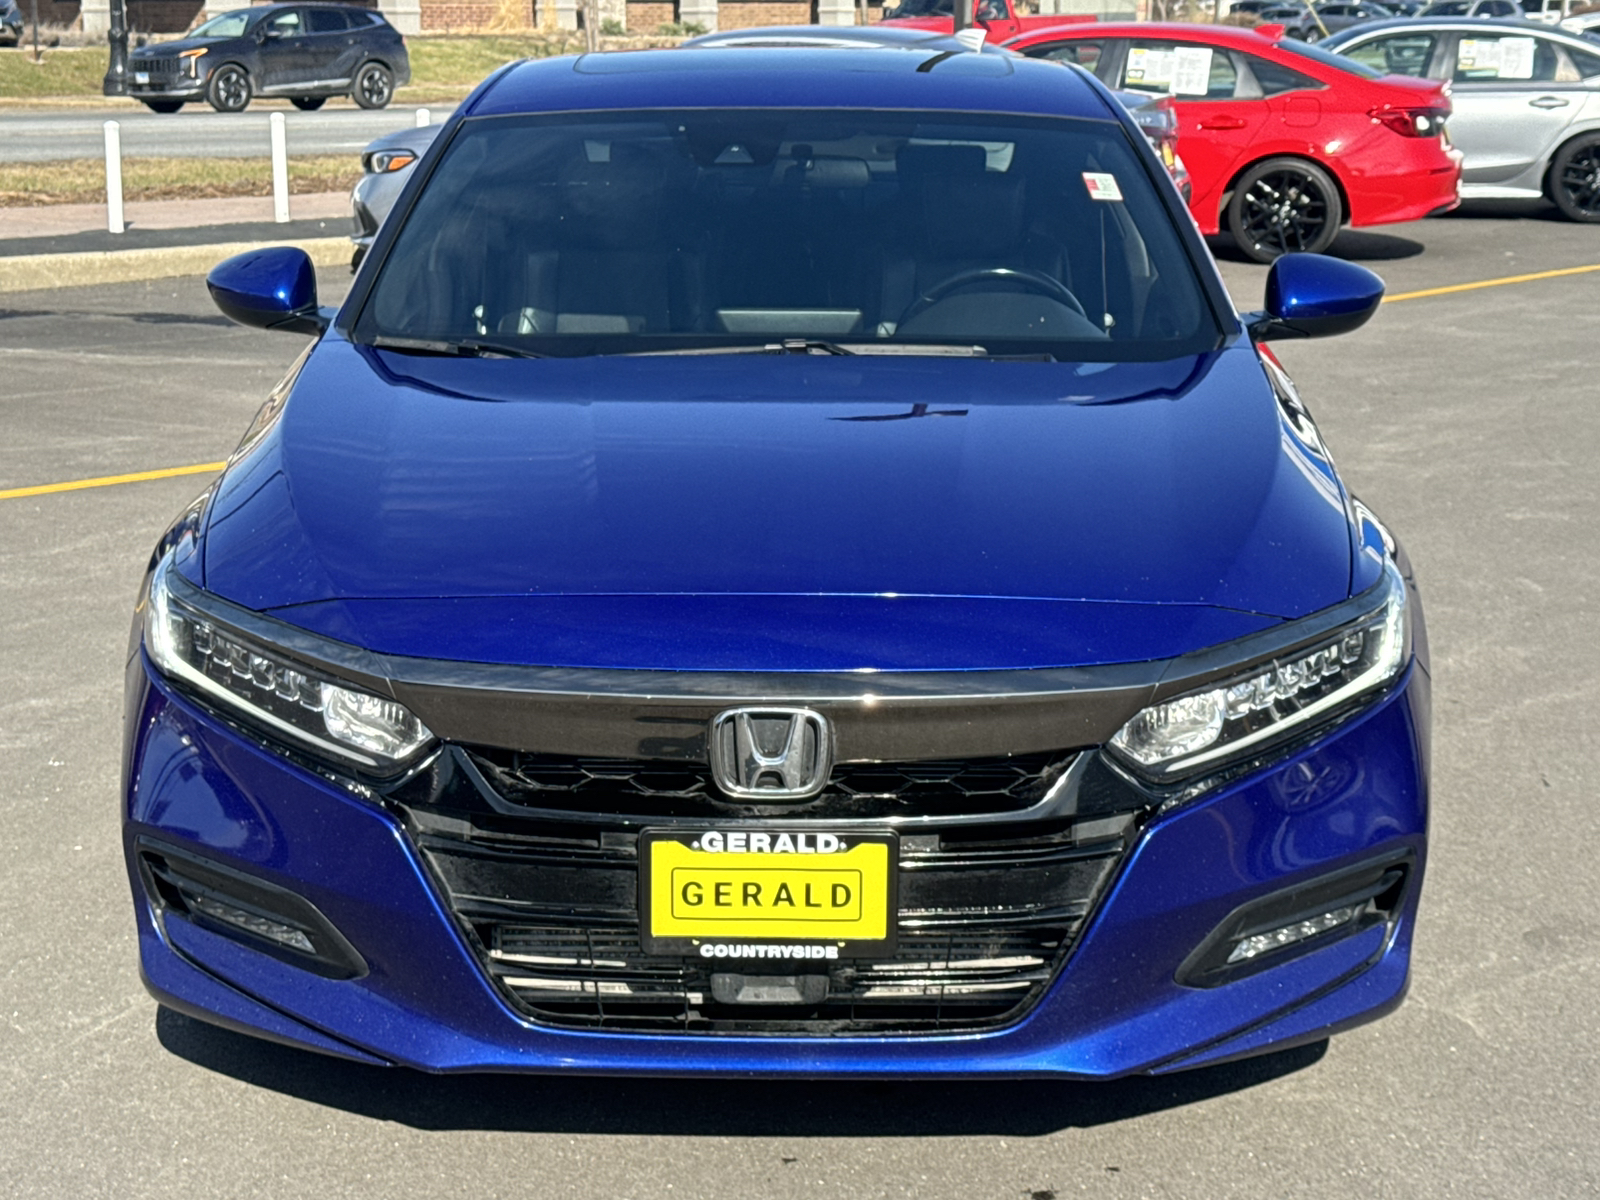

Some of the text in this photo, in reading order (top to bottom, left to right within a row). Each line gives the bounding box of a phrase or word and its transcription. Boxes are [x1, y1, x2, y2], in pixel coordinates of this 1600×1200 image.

[700, 831, 839, 854] GERALD
[681, 881, 852, 908] GERALD
[699, 944, 839, 959] COUNTRYSIDE
